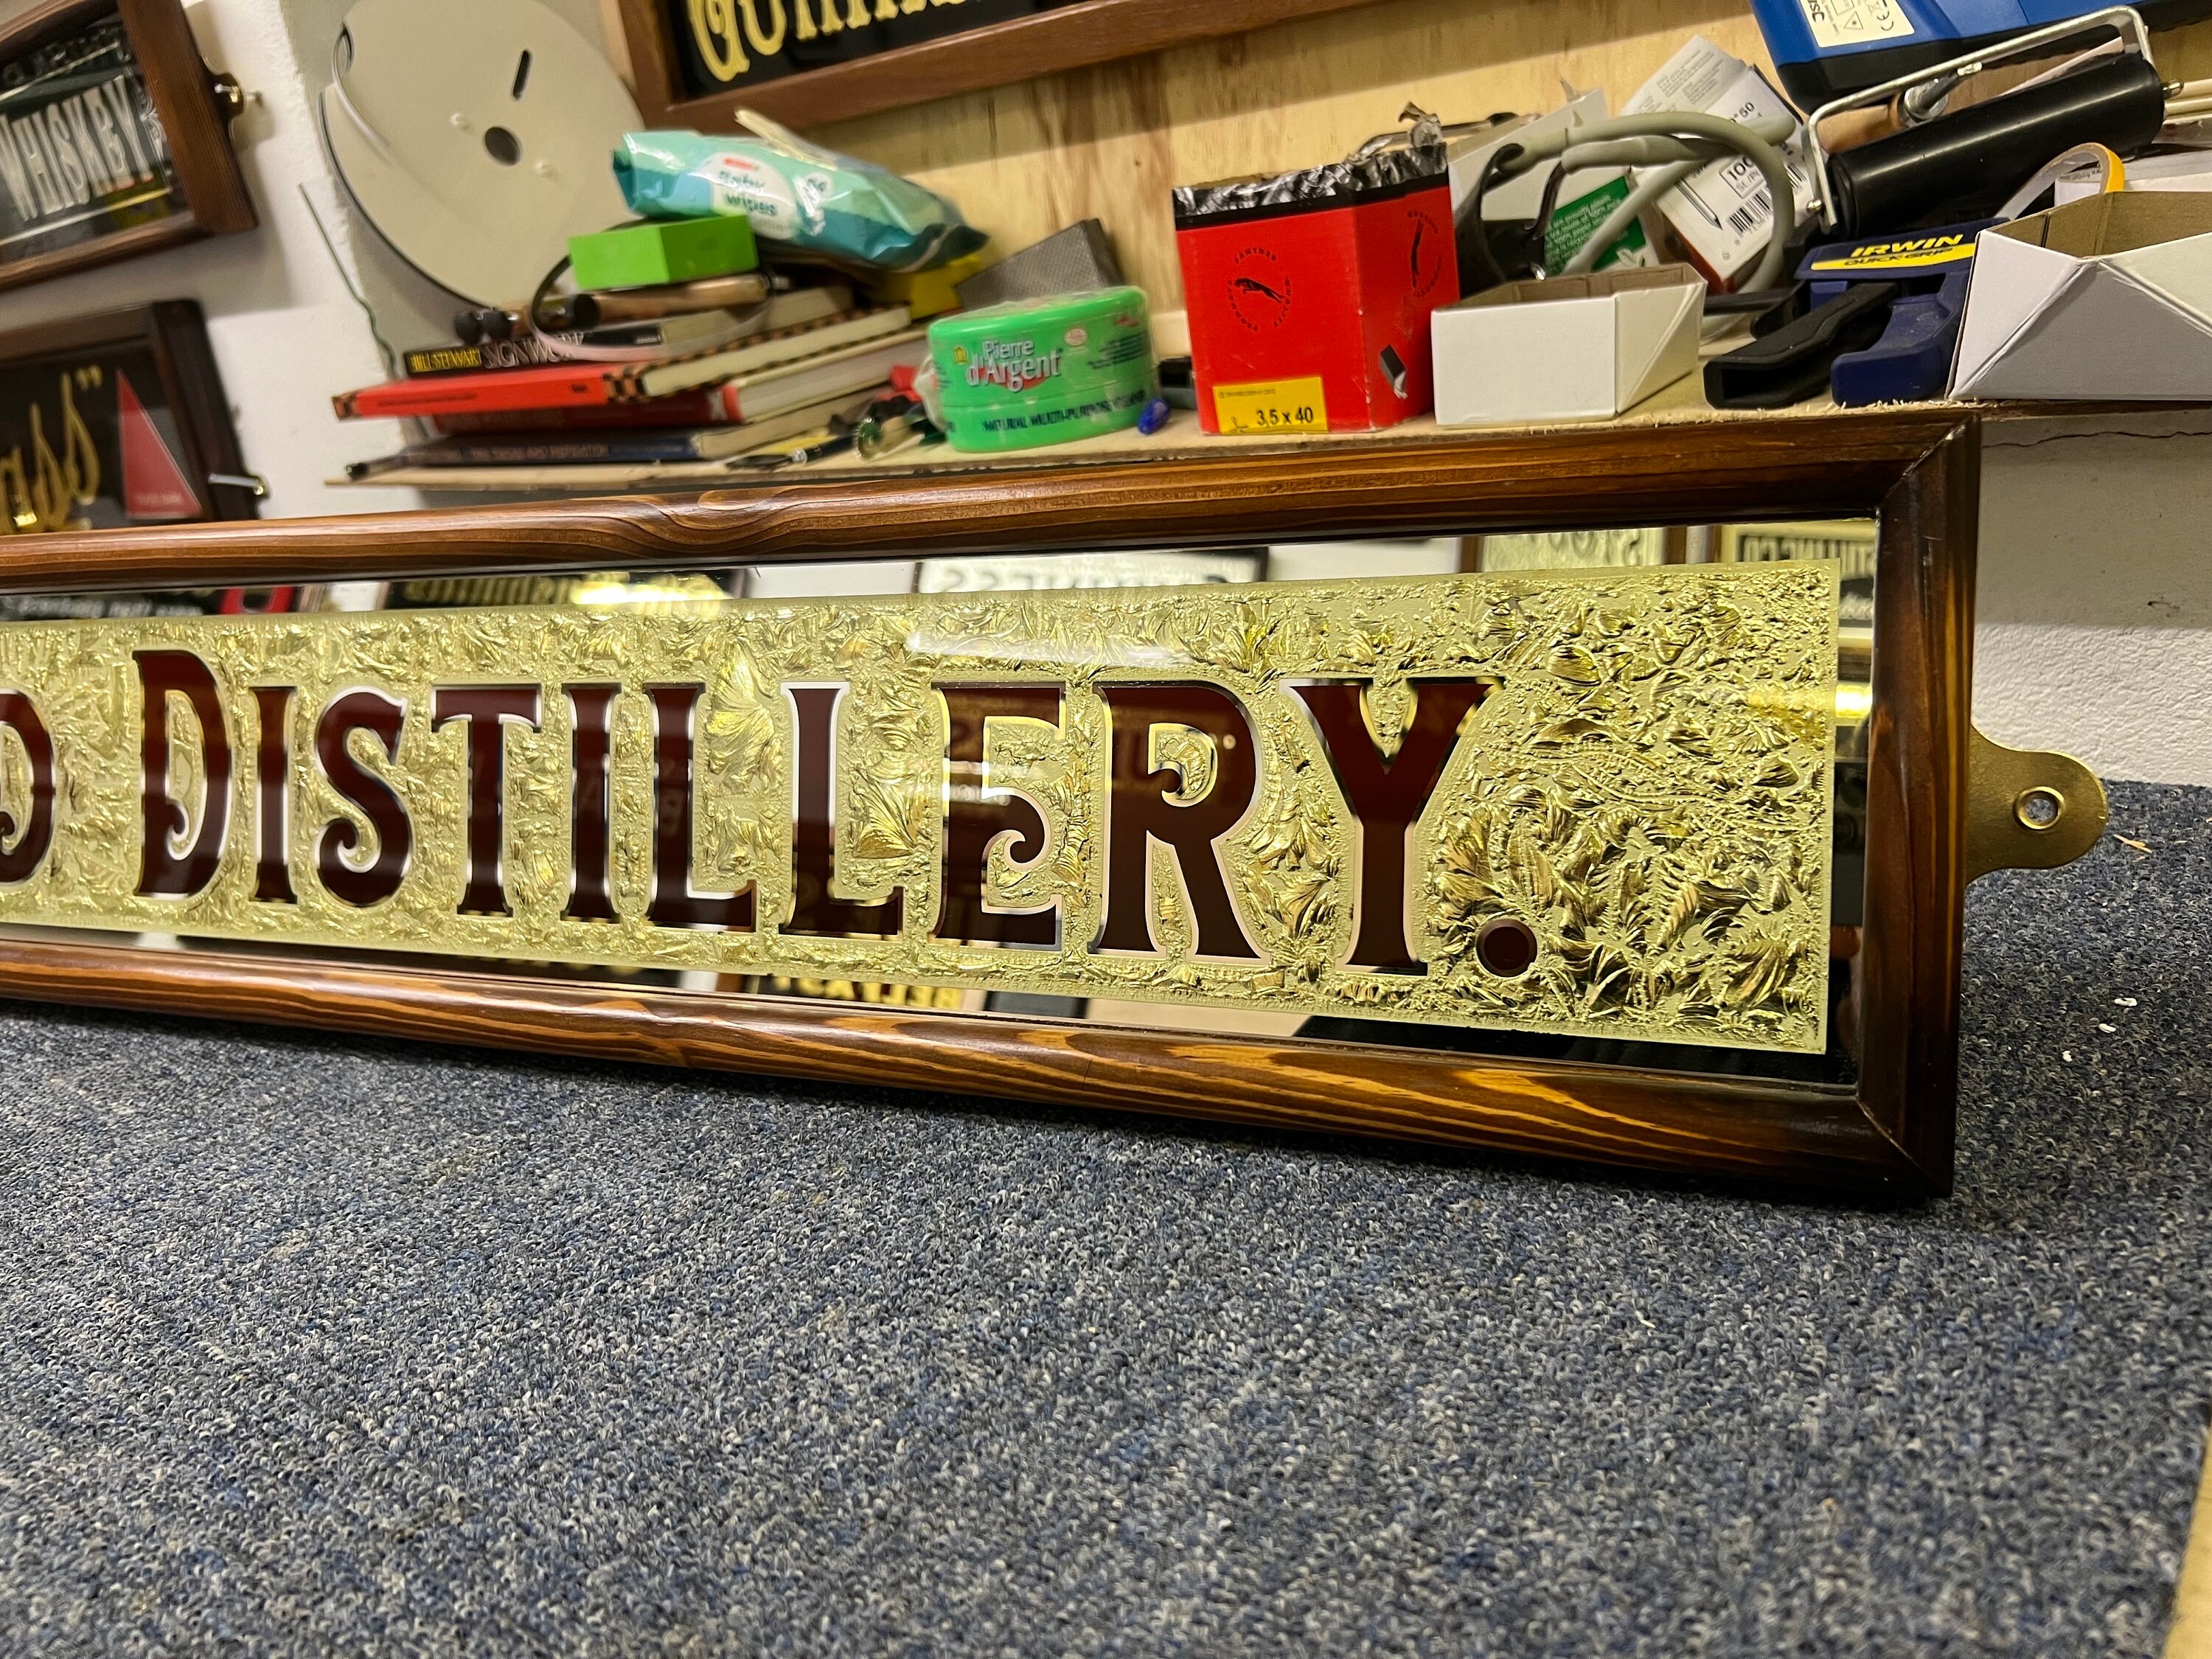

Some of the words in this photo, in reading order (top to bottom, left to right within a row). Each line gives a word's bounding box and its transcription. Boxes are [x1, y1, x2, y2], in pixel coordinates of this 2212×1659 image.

[1850, 234, 1964, 258] IRWIN
[982, 340, 1035, 361] Pierre
[965, 349, 1063, 393] d'Argent
[1295, 406, 1314, 425] 40
